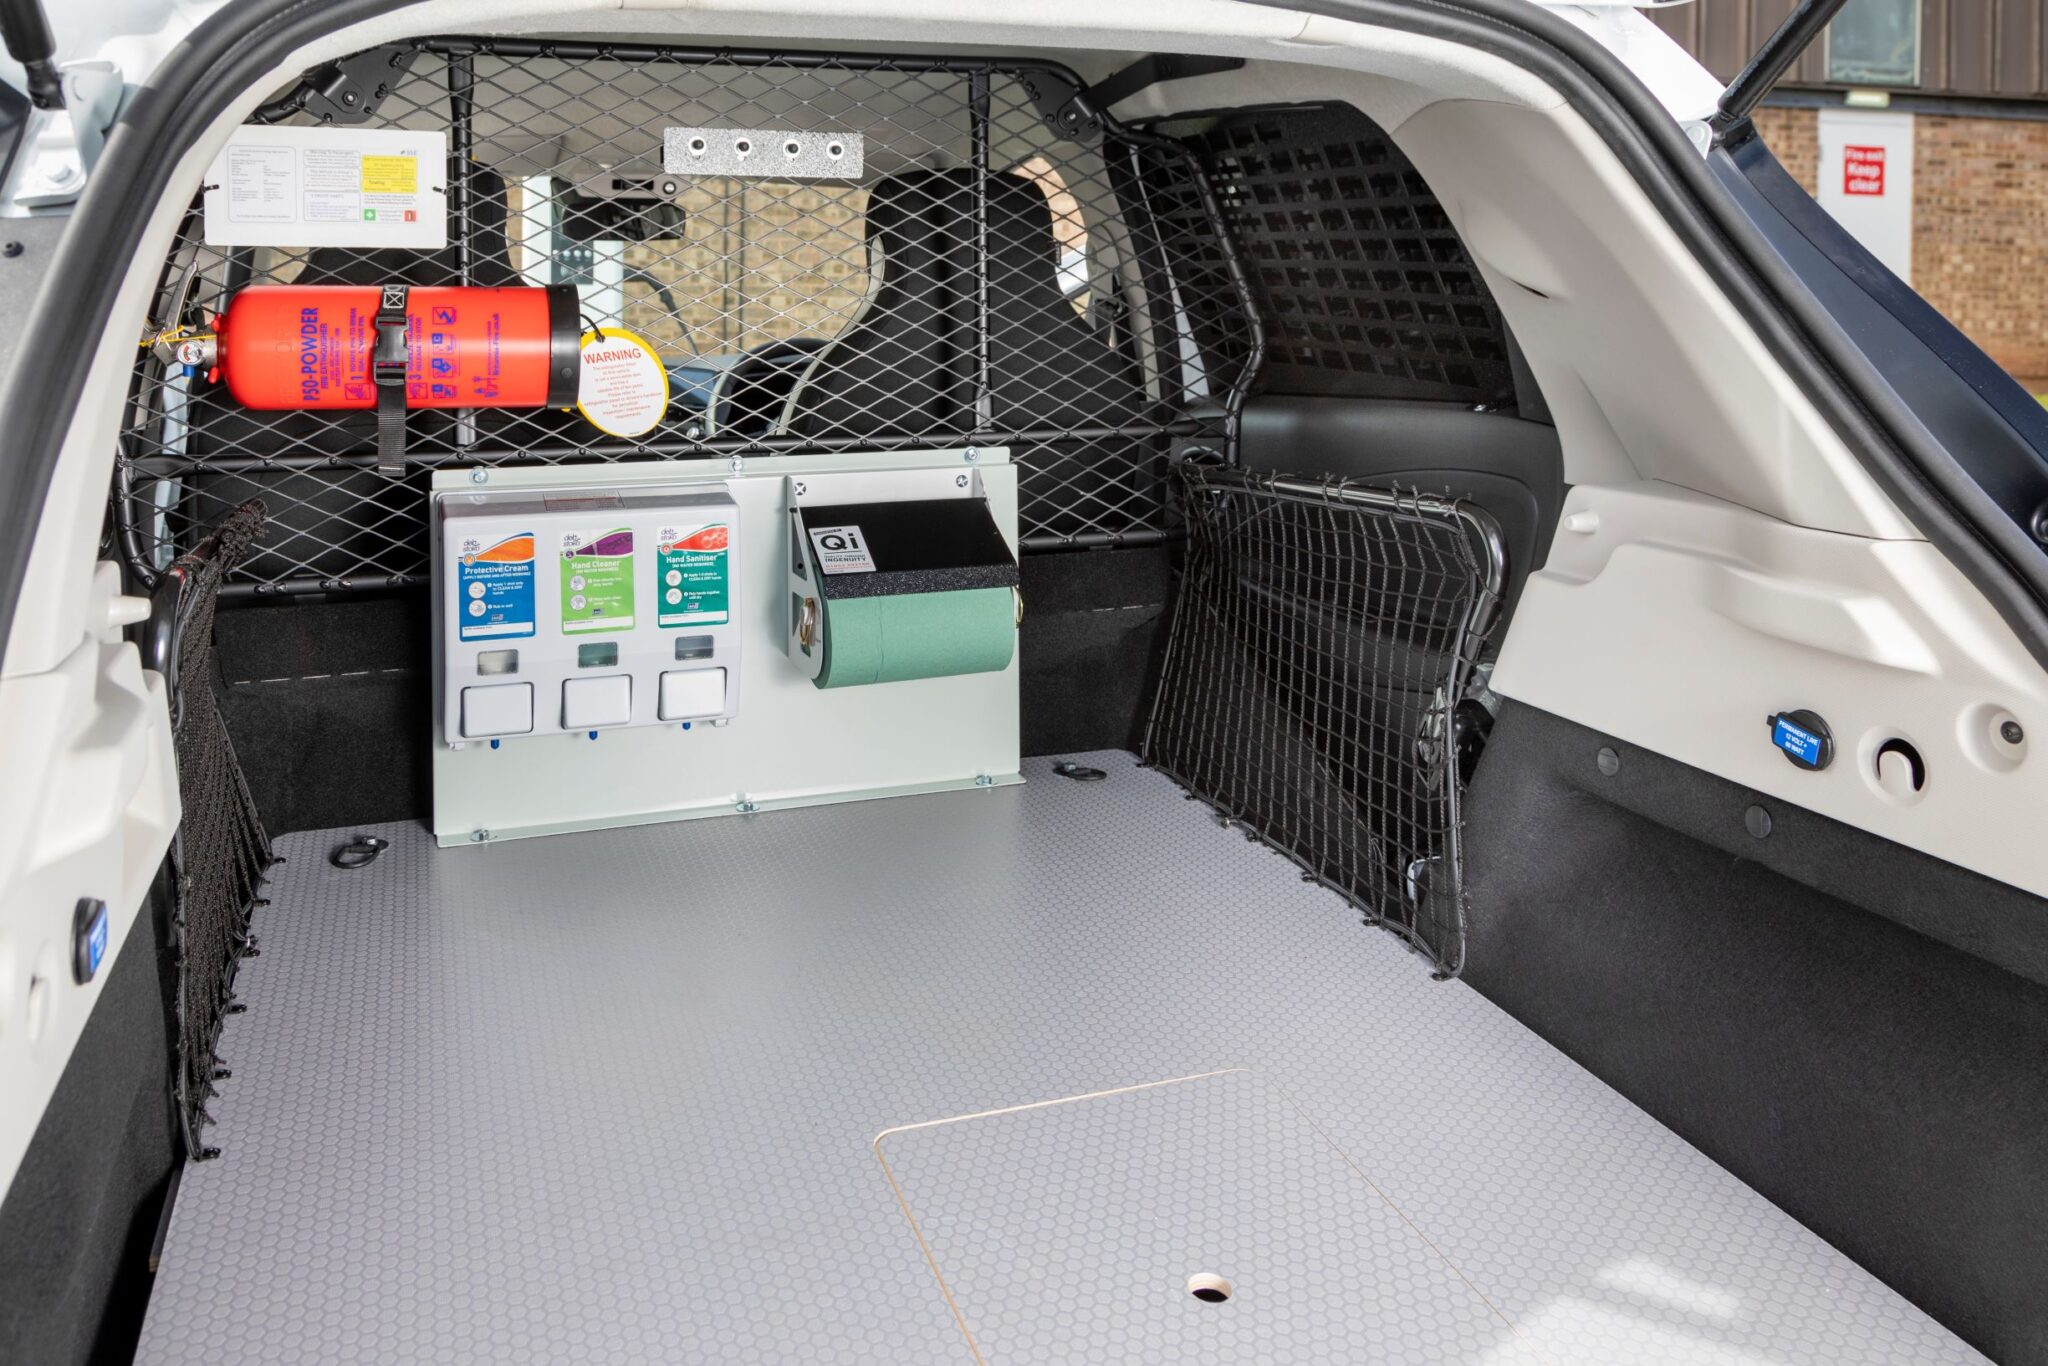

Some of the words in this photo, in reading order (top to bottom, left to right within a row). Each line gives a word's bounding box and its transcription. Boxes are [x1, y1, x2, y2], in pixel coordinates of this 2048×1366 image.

[1847, 149, 1863, 161] Fire
[1866, 150, 1885, 162] exit
[1848, 162, 1880, 179] Keep
[1849, 179, 1880, 192] clear
[301, 307, 320, 401] P50-POWDER
[320, 323, 328, 375] EXTINGUISHER
[583, 348, 642, 365] WARNING
[820, 533, 859, 550] Qi
[592, 560, 620, 568] Cleaner
[686, 554, 718, 562] Sanitiser
[464, 566, 502, 574] Protective
[1778, 720, 1807, 740] PERMANENT
[1791, 735, 1804, 747] VOLT
